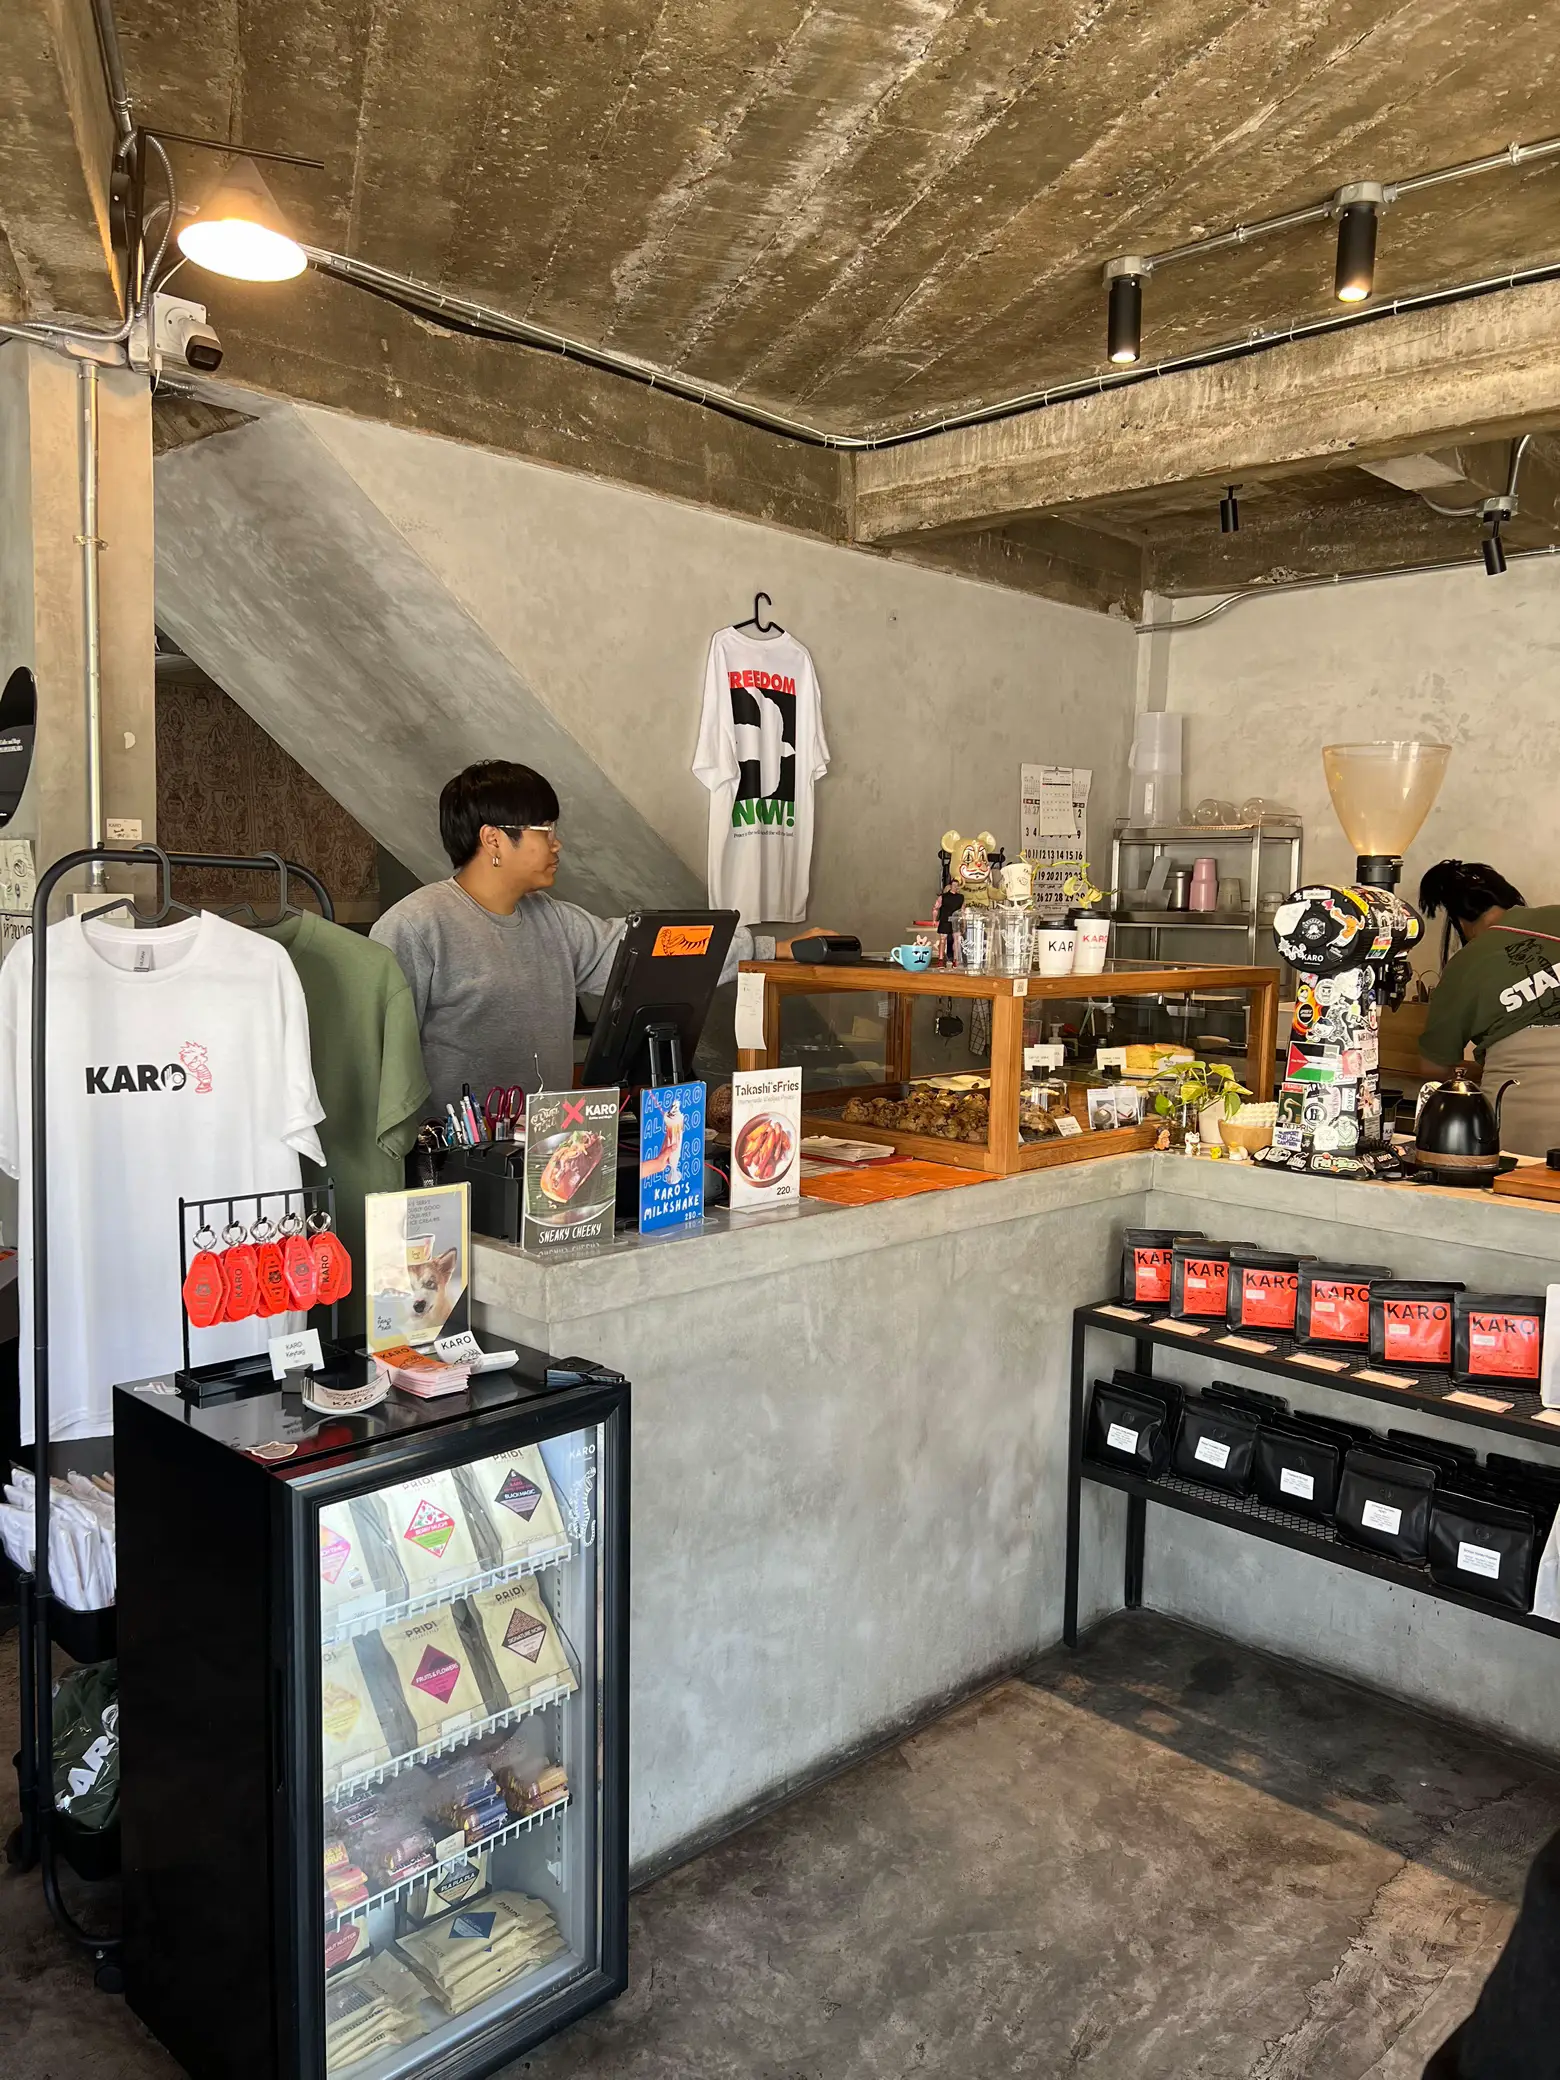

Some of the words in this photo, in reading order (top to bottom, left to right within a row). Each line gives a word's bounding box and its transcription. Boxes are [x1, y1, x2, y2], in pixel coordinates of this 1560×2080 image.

[1078, 809, 1082, 818] 2
[1026, 827, 1030, 836] 3
[1033, 828, 1037, 837] 4
[1032, 850, 1038, 859] 11
[1040, 850, 1046, 859] 12
[1048, 850, 1054, 859] 13
[1056, 850, 1064, 860] 14
[1066, 851, 1074, 860] 15
[1076, 851, 1083, 860] 16
[1038, 872, 1046, 880] 19
[1046, 872, 1054, 880] 20
[1056, 872, 1062, 880] 21
[1036, 893, 1044, 902] 26
[1044, 893, 1052, 902] 27
[1054, 893, 1063, 902] 28
[85, 1063, 187, 1094] KARO
[586, 1103, 617, 1116] KARO
[644, 1110, 701, 1140] ALRO
[644, 1138, 701, 1160] ALRO
[654, 1182, 690, 1201] KARO'S
[644, 1194, 700, 1221] MILKSHAKE
[538, 1226, 570, 1244] SNEAKY
[572, 1222, 602, 1239] CHEEKY
[1137, 1251, 1172, 1265] KAR
[321, 1254, 330, 1282] KARO
[1187, 1262, 1229, 1278] KAR
[1246, 1272, 1298, 1290] KARO
[1314, 1283, 1370, 1302] KARO
[1387, 1303, 1448, 1321] KARO
[1472, 1316, 1536, 1336] KARO
[285, 1341, 303, 1350] KARO
[440, 1335, 472, 1350] KARO
[380, 1347, 410, 1360] KARO
[333, 1394, 374, 1406] KARO
[569, 1444, 596, 1458] KARO
[402, 1476, 436, 1492] PRIDI
[495, 1584, 525, 1602] PRIDI
[405, 1620, 438, 1638] PRIDI
[416, 1673, 432, 1684] FRUITS
[436, 1664, 459, 1675] FLOWERS
